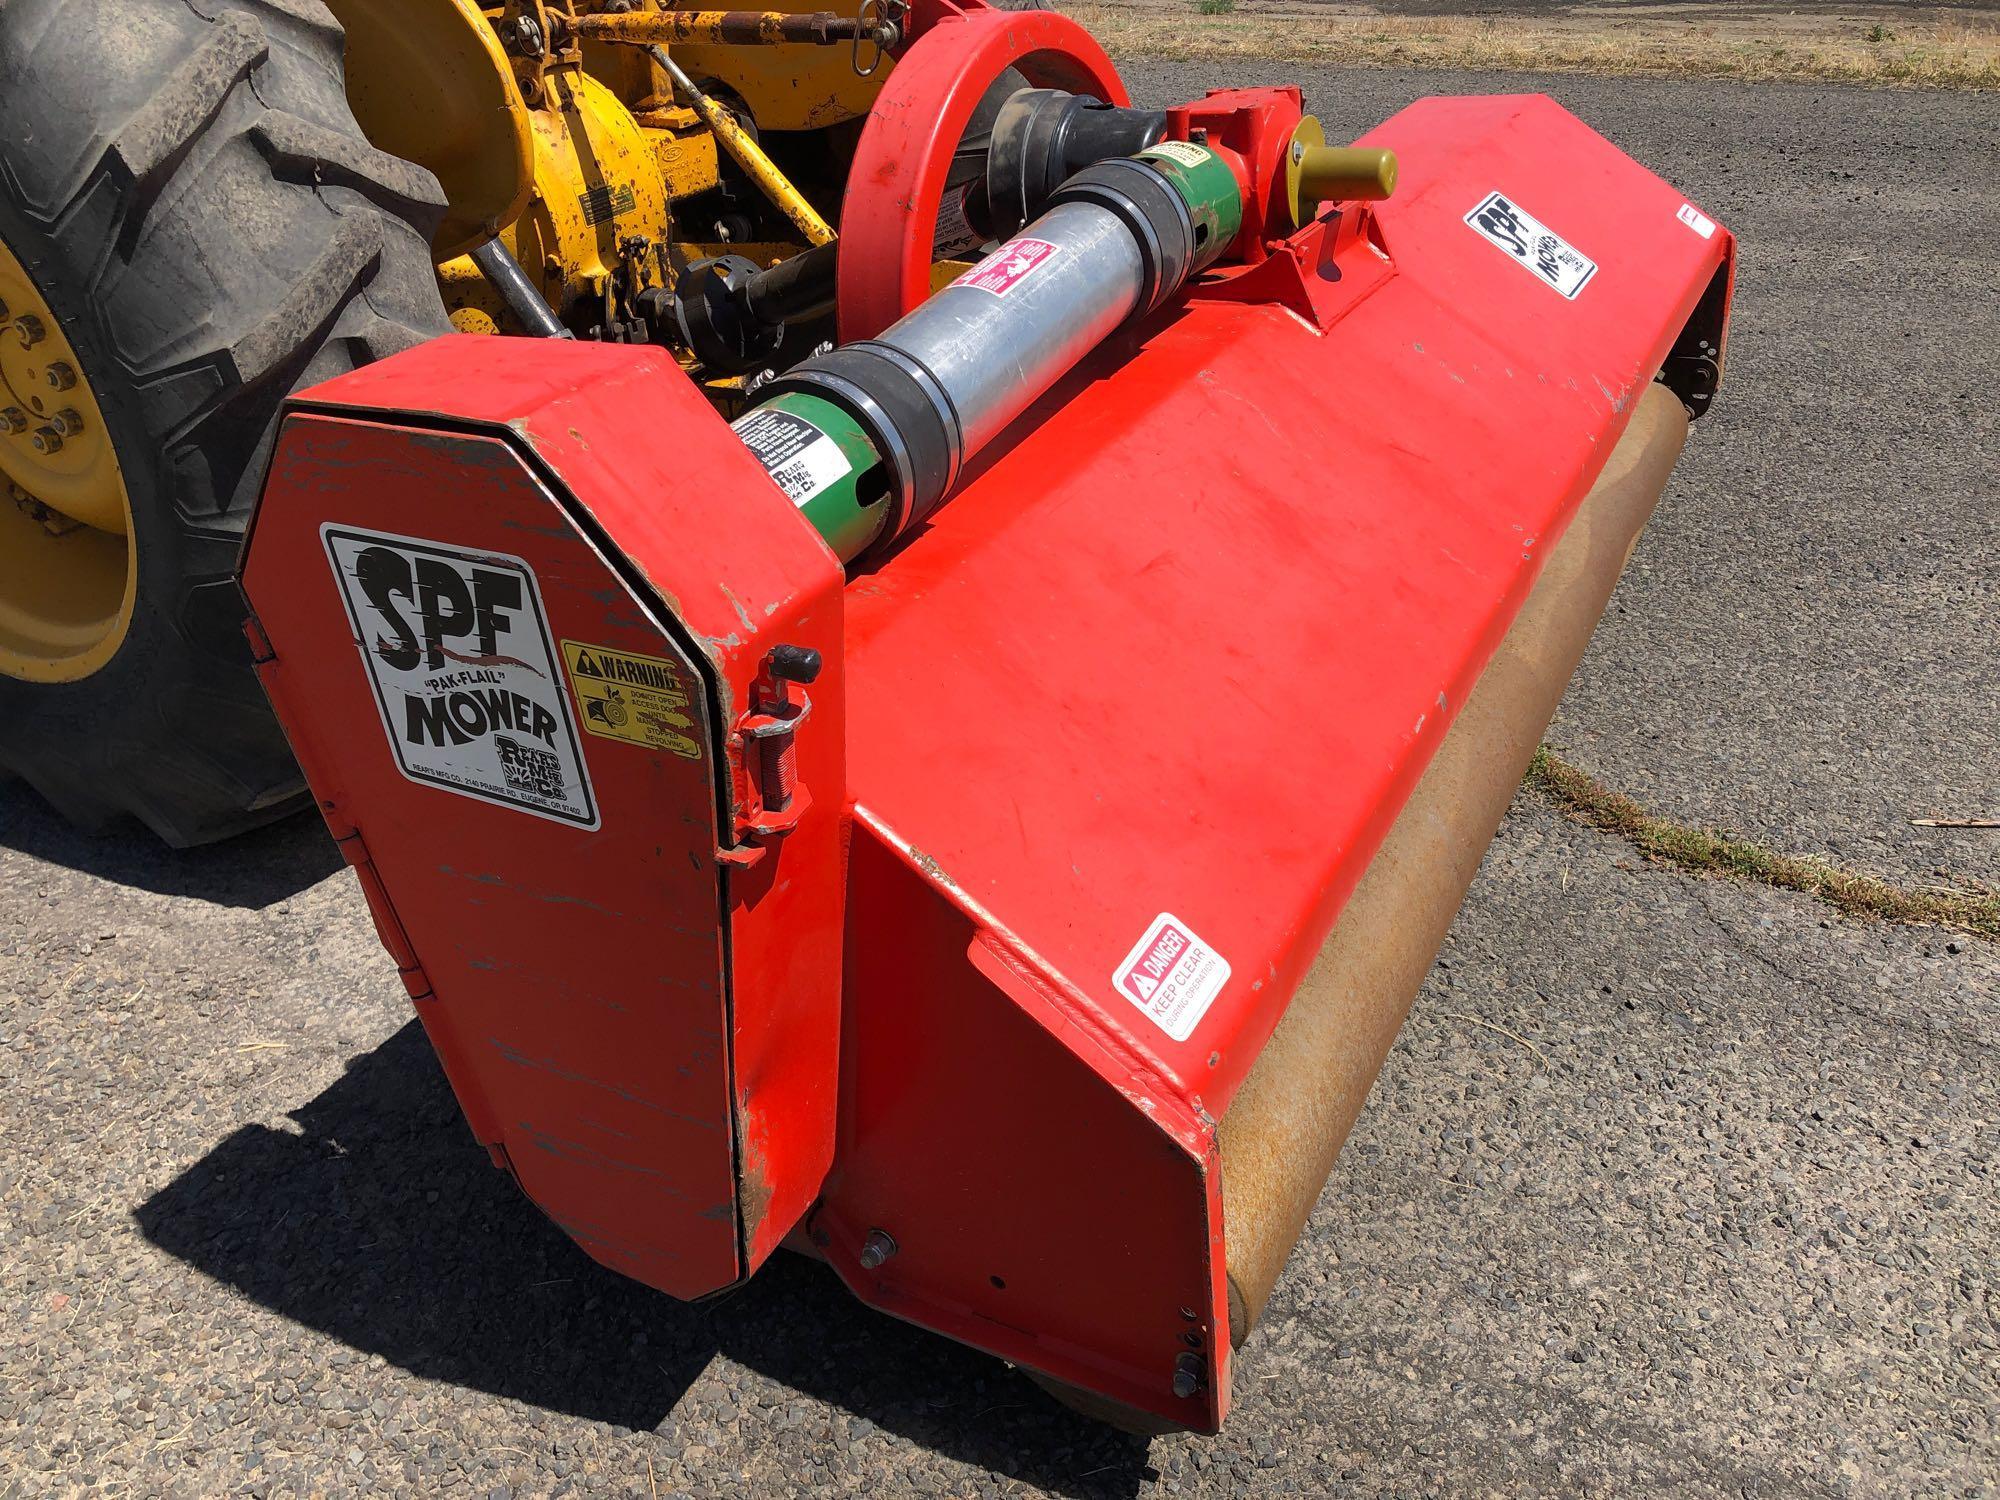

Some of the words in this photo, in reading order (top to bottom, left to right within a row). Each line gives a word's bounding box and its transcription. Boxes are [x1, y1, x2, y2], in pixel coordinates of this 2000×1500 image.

[1478, 198, 1529, 257] SPF
[1536, 235, 1564, 283] MOWER
[352, 546, 523, 673] SPF
[405, 688, 559, 752] MOWER
[632, 699, 660, 711] ACCESS
[648, 727, 679, 740] STOPPED
[479, 781, 507, 794] PRAIRIE
[561, 804, 582, 816] 97402
[1142, 929, 1187, 979] DANGER
[1152, 983, 1178, 1017] KEEP
[1174, 948, 1206, 986] CLEAR
[1166, 997, 1189, 1028] DURING
[1185, 959, 1216, 999] OPERATION
